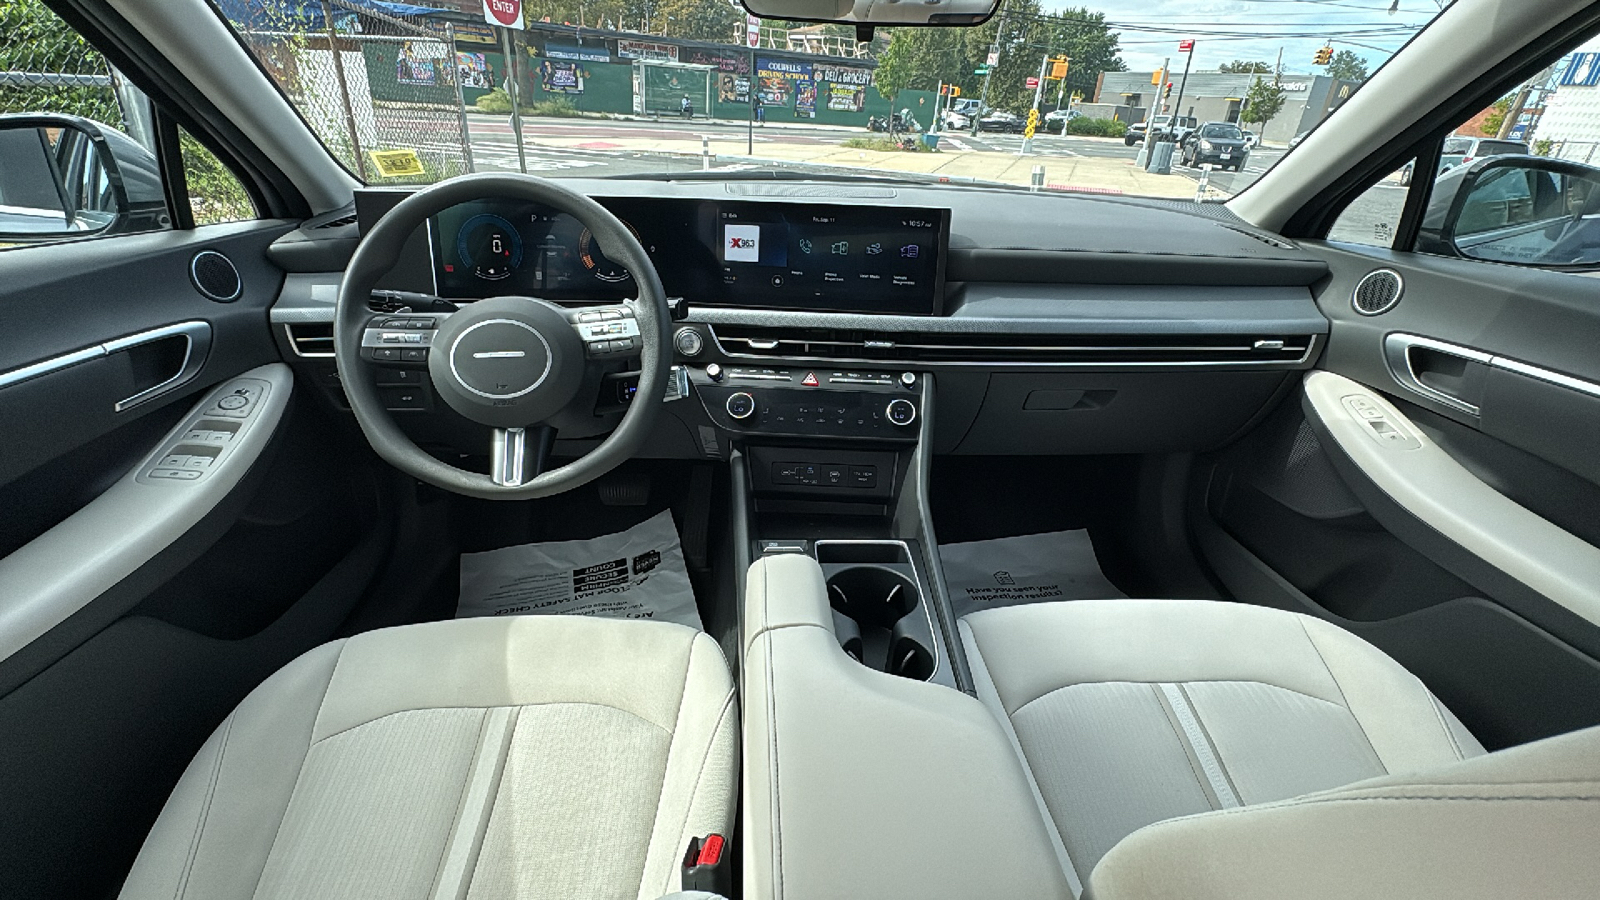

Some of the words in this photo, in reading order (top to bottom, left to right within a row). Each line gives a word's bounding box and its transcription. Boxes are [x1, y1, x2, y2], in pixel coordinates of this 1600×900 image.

[492, 1, 515, 13] ENTER
[758, 70, 784, 79] DRIVING
[785, 72, 809, 80] SCHOOL
[824, 70, 838, 82] DELI
[843, 72, 870, 84] GROCERY
[531, 214, 537, 222] P
[492, 240, 502, 253] 0
[584, 562, 616, 574] COUNT
[584, 571, 619, 582] SECURE
[965, 587, 992, 595] Have
[1036, 584, 1058, 592] your
[574, 592, 594, 601] MAT
[533, 597, 571, 609] SAFETY
[494, 605, 531, 616] CHECK
